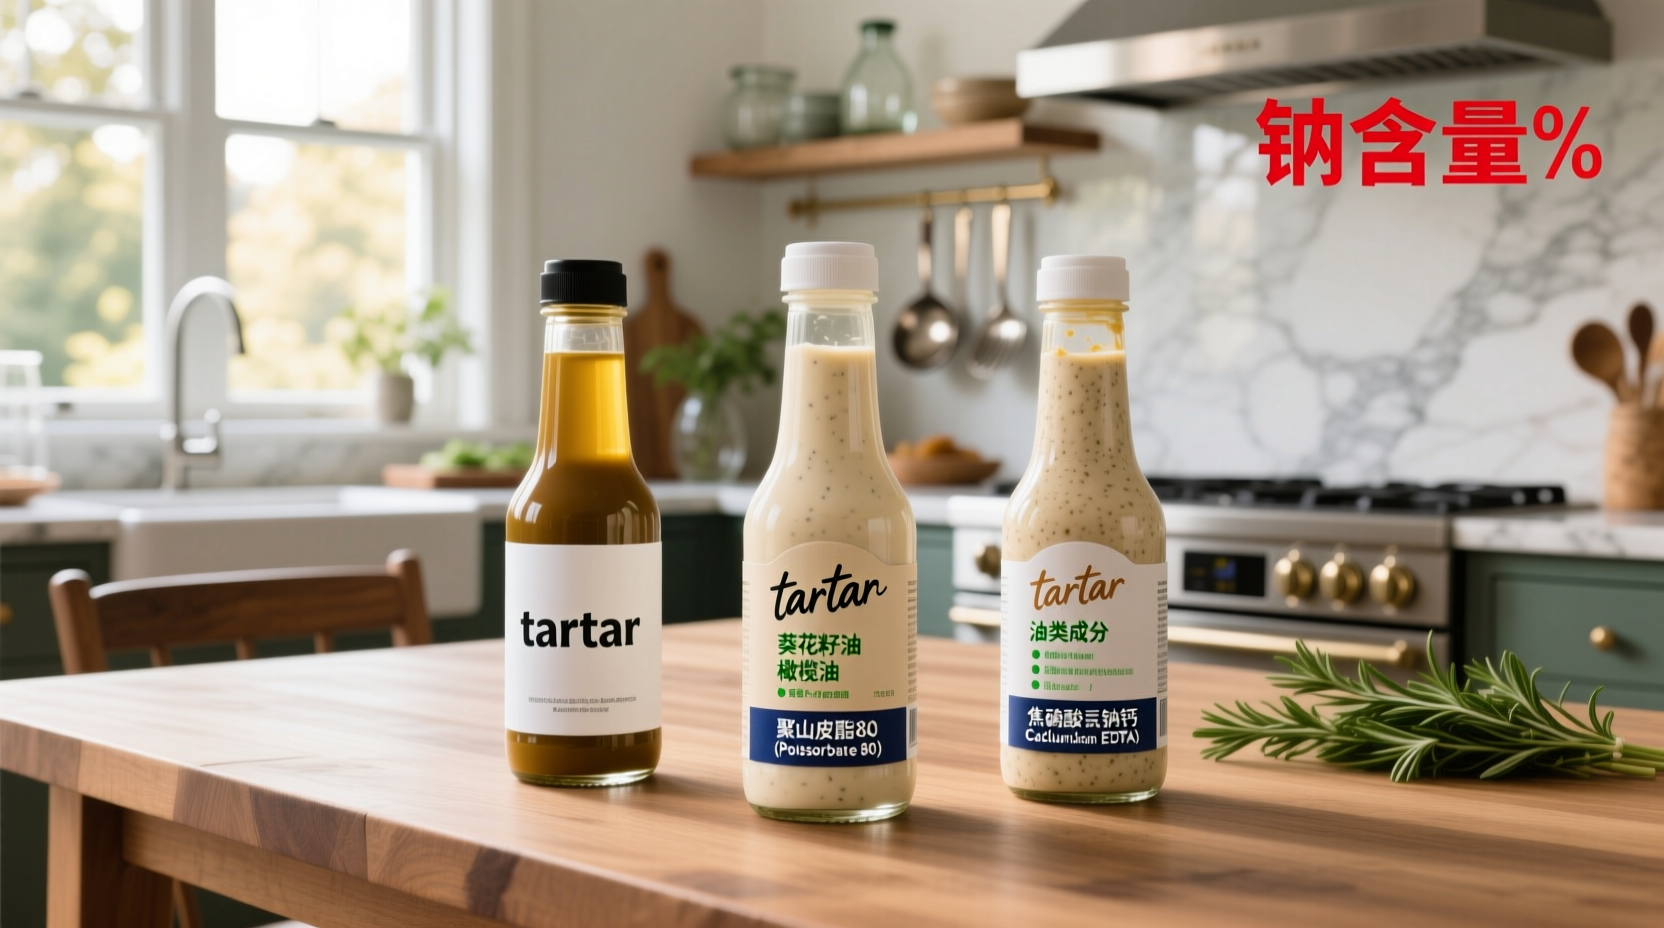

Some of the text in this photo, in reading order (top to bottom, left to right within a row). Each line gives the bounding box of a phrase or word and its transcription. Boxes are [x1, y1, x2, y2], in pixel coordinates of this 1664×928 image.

[1030, 565, 1125, 610] tartar
[520, 611, 641, 648] tartar
[1030, 620, 1109, 643] 油类成分
[778, 632, 861, 656] 葵花籽油
[777, 659, 839, 682] 橄榄油
